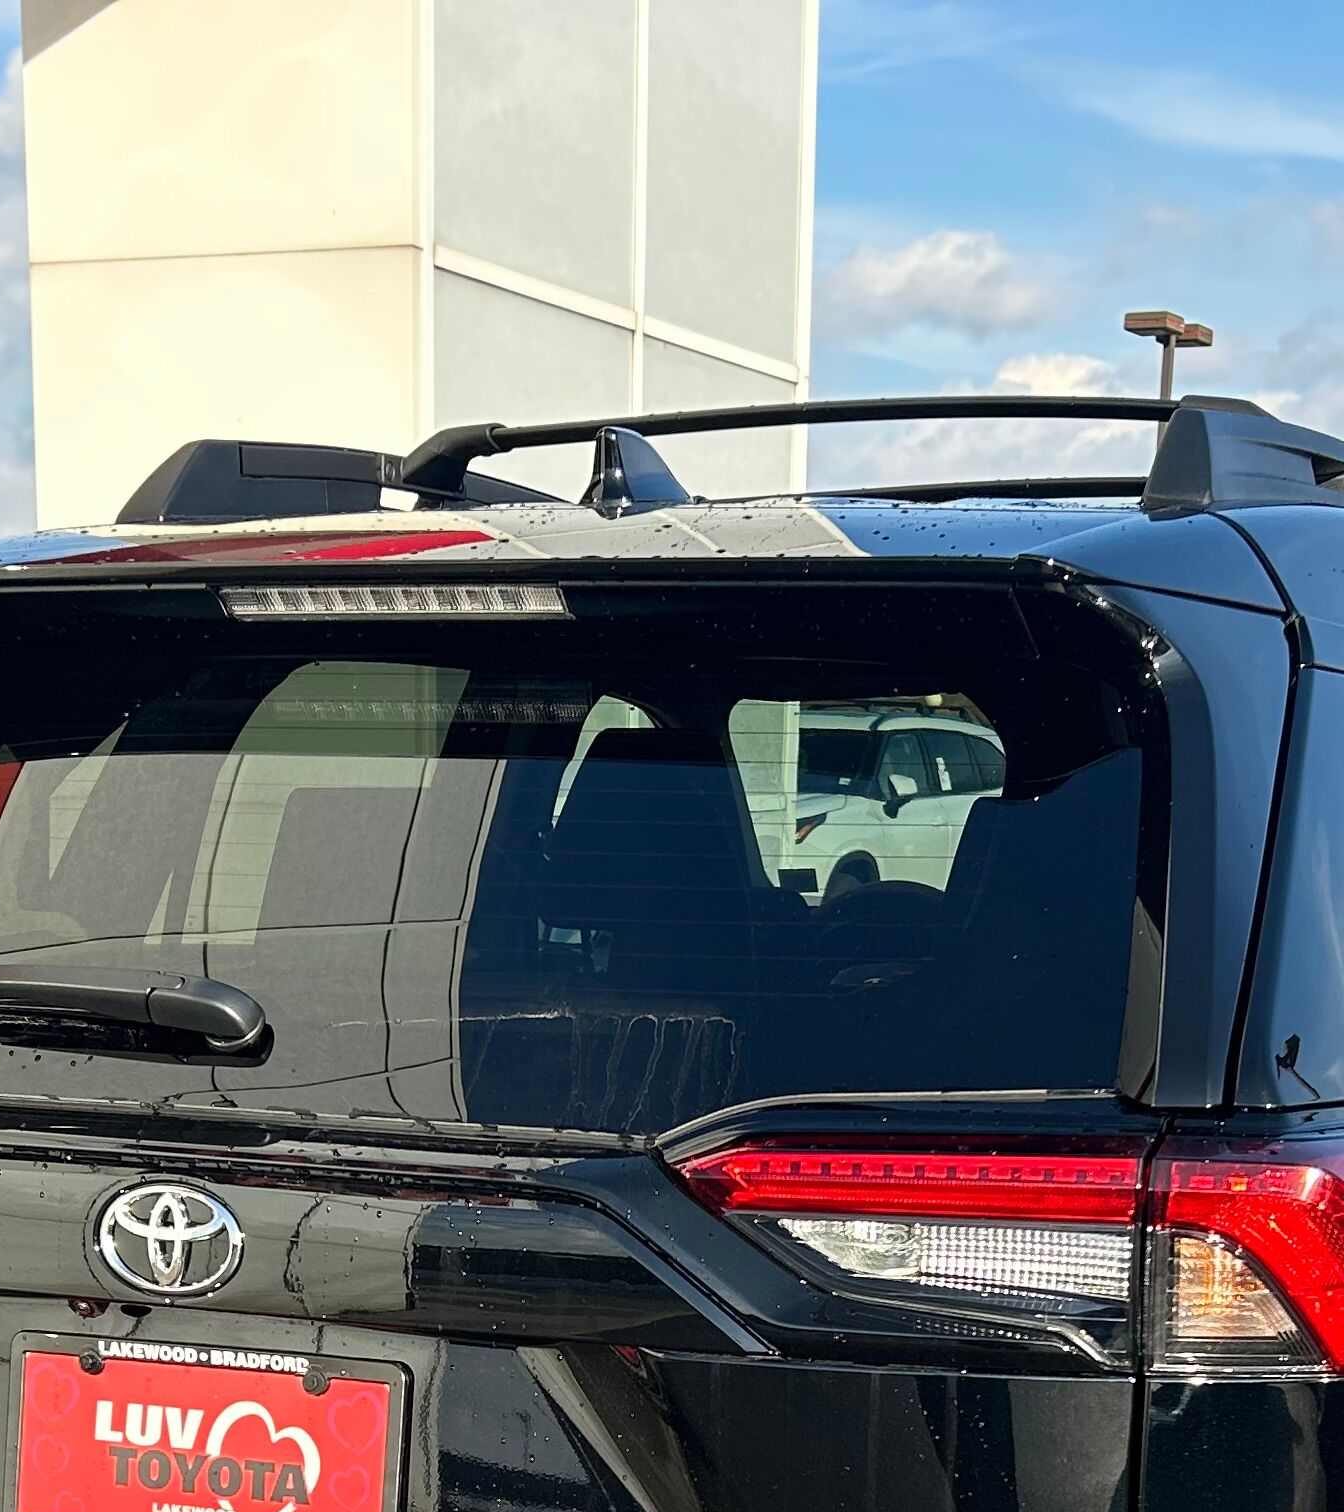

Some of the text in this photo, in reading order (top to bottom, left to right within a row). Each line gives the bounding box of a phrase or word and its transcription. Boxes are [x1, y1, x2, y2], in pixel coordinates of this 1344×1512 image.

[98, 1340, 310, 1374] LAKEWOOD BRADFORD
[94, 1400, 204, 1450] LUV
[108, 1446, 310, 1505] TOYOTA
